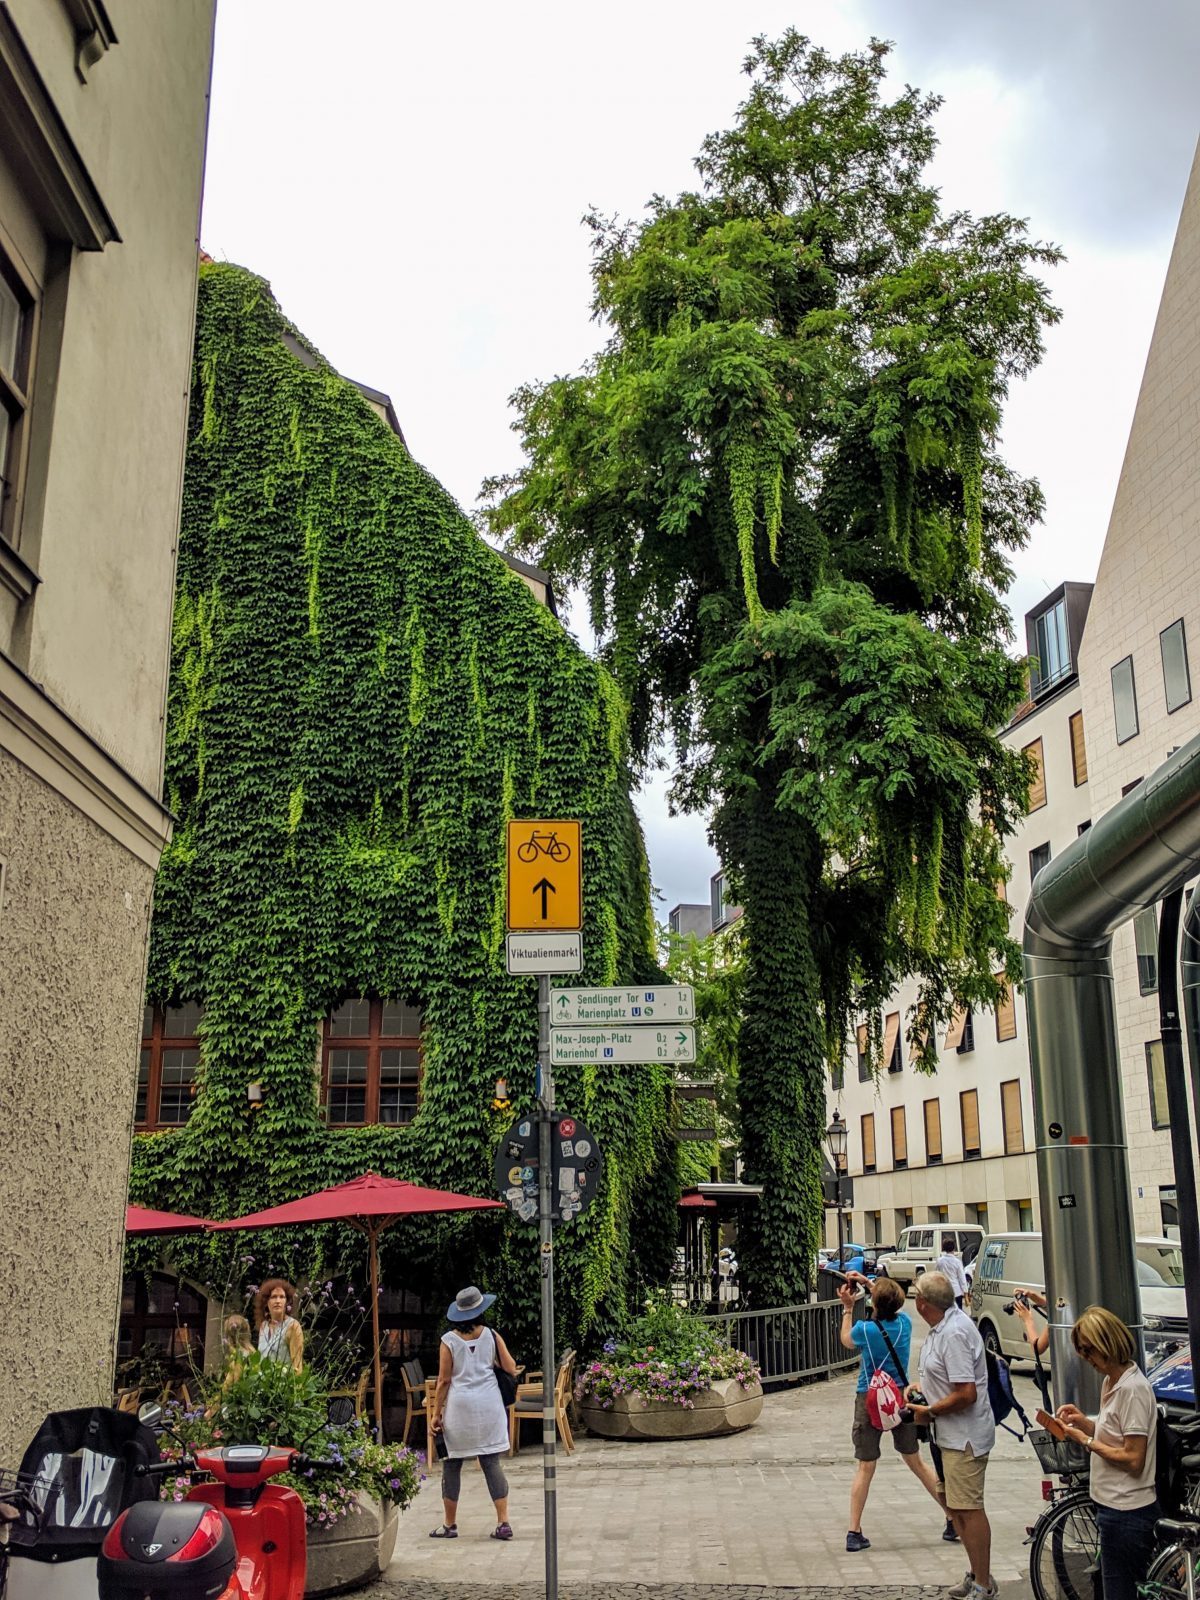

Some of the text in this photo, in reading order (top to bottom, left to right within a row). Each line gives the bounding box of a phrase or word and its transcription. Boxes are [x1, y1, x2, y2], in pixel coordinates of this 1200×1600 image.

[511, 947, 578, 959] Viktualienmarkt
[577, 994, 622, 1005] Sendlinger
[626, 993, 639, 1003] Tor
[577, 1008, 626, 1020] Marienplatz
[555, 1033, 632, 1046] Max-Joseph-Platz
[556, 1048, 598, 1058] Marienhof
[980, 1259, 1004, 1280] KLIMA
